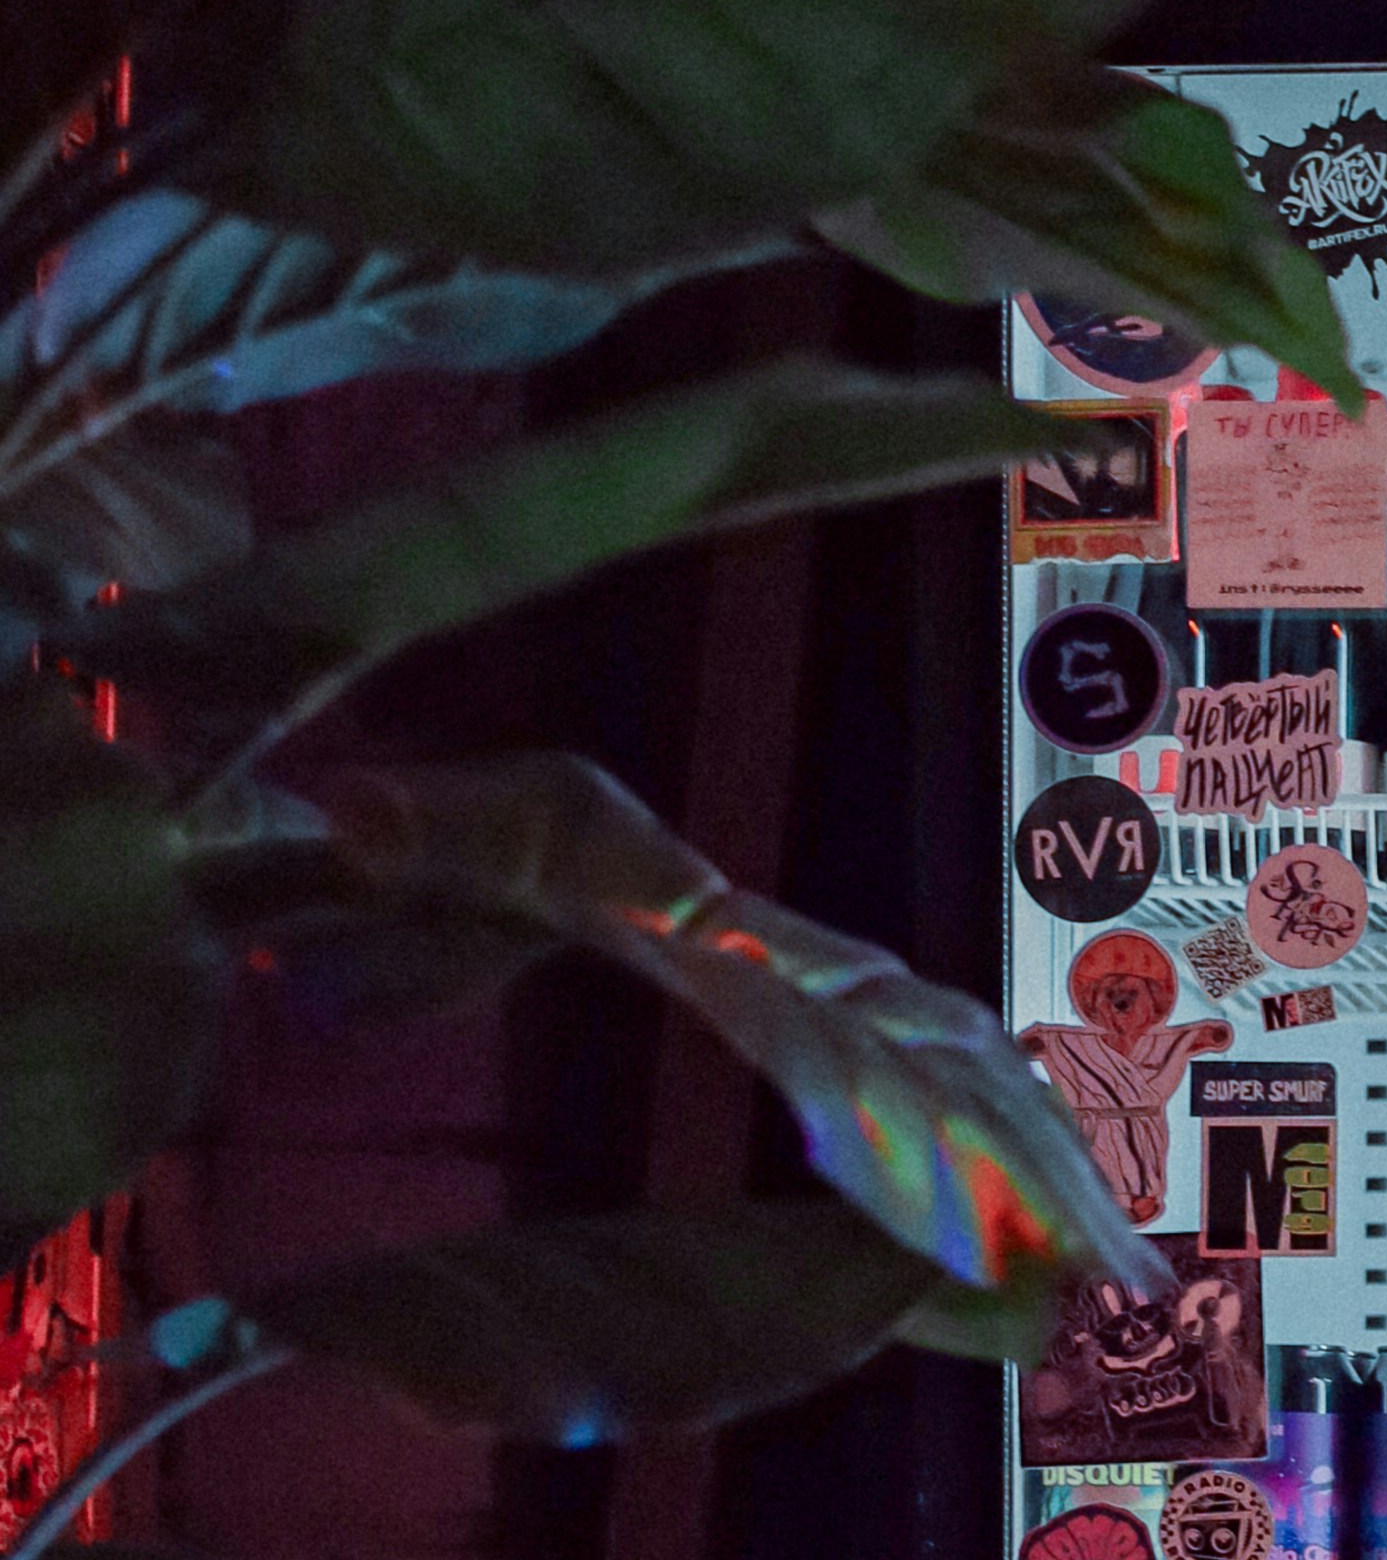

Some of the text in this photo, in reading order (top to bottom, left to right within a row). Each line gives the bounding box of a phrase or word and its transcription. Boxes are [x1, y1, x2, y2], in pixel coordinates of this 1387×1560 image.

[1202, 1079, 1328, 1103] SUPER SMURF
[1183, 1472, 1247, 1496] RADIO
